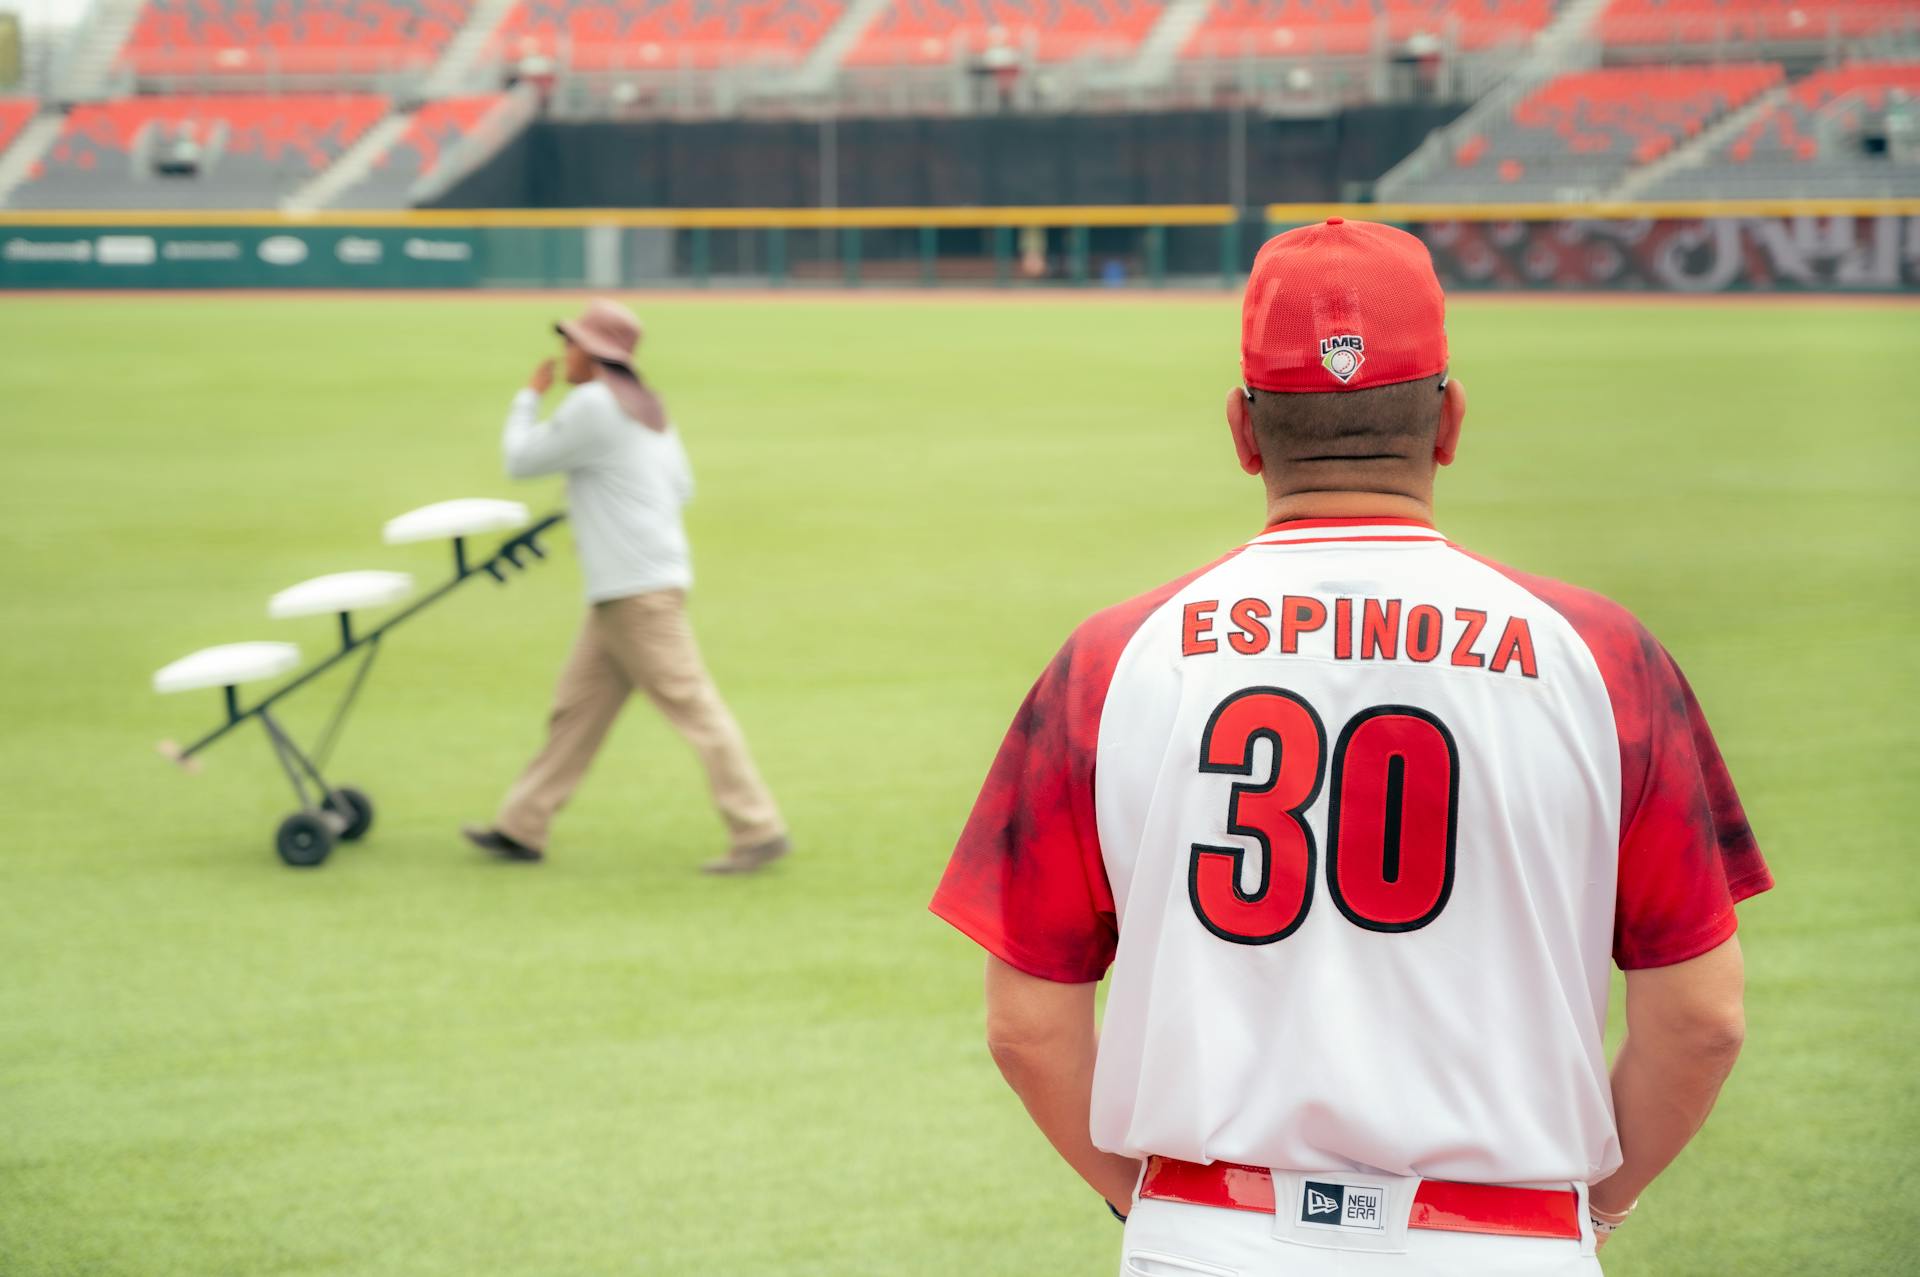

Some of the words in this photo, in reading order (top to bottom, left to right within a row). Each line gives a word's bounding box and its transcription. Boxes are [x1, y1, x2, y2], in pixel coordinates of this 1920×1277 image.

[1320, 335, 1364, 356] LMB
[1182, 595, 1539, 679] ESPINOZA
[1188, 685, 1460, 946] 30
[1348, 1194, 1377, 1208] NEW
[1347, 1206, 1376, 1220] ERA
